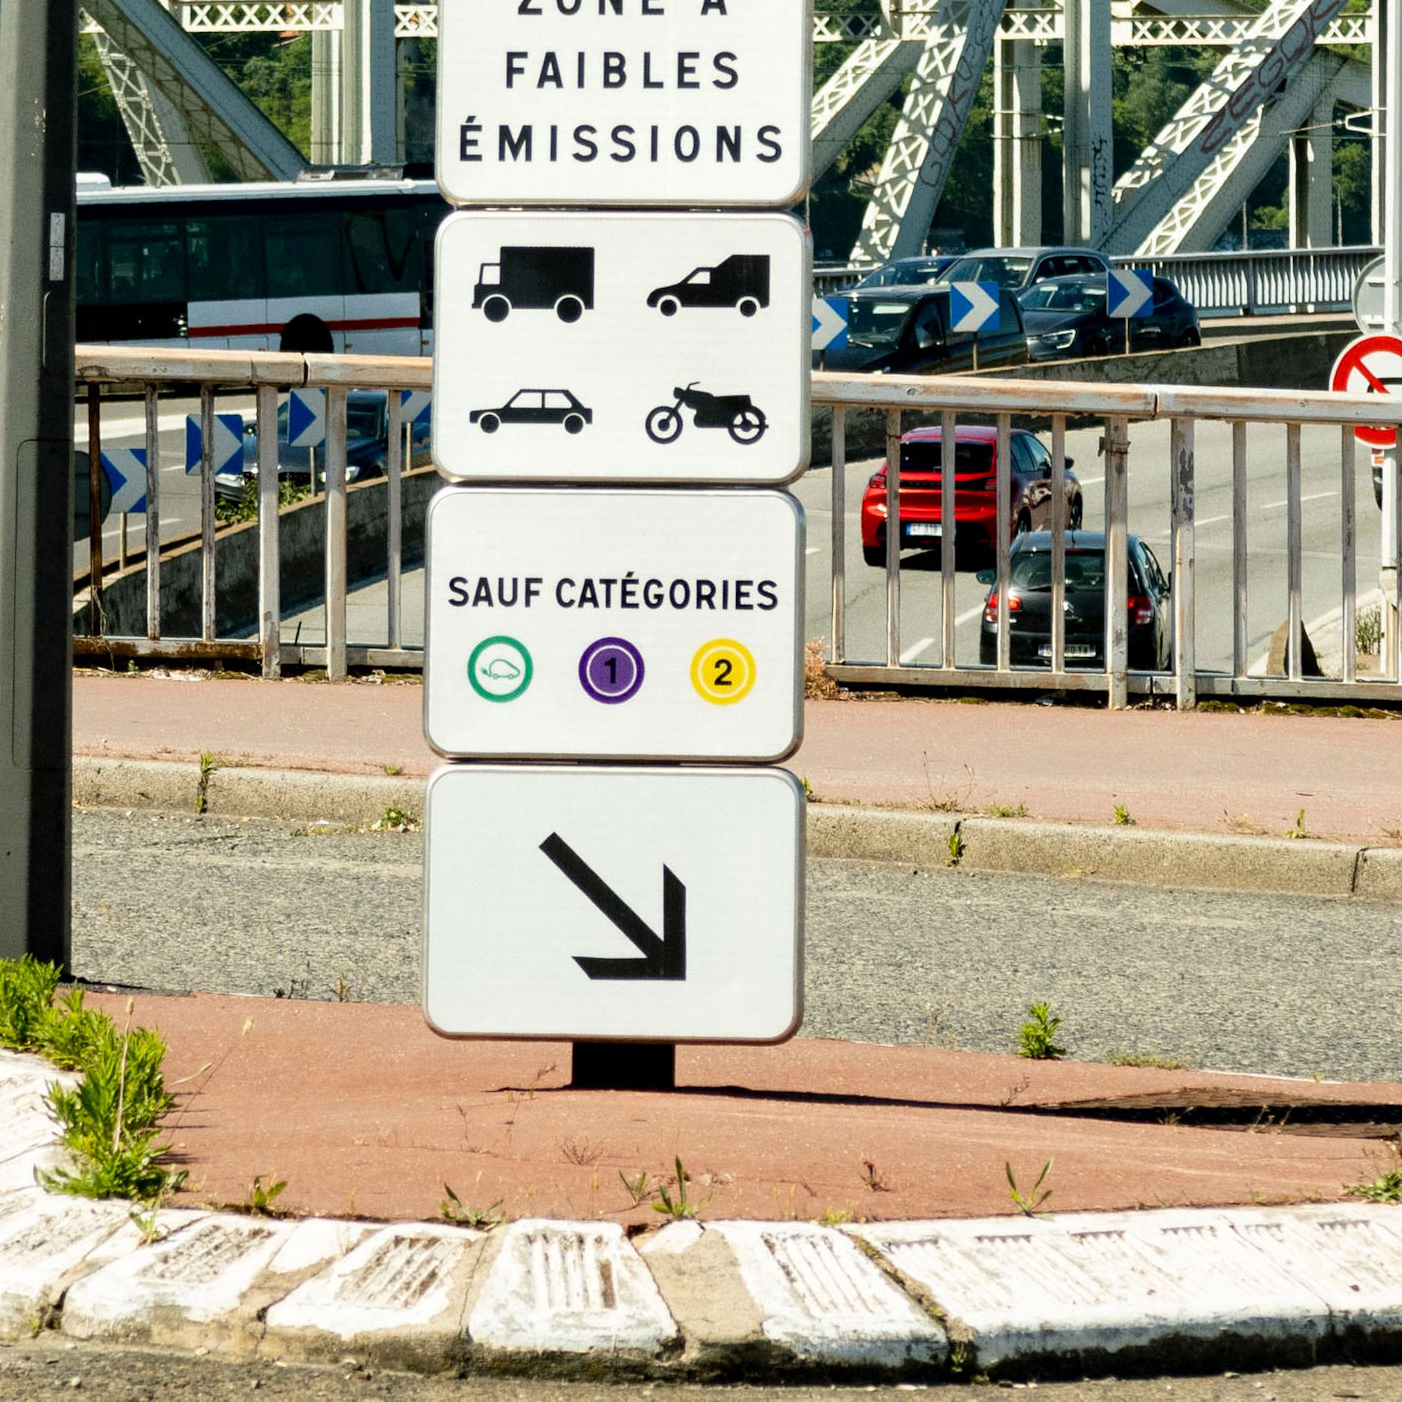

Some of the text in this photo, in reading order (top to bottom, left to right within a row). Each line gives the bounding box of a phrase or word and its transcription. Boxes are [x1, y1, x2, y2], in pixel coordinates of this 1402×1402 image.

[507, 52, 738, 89] FAIBLES
[460, 116, 781, 163] ÉMISSIONS
[449, 572, 778, 611] SAUF CATÉGORIES
[604, 657, 733, 686] 1 2
